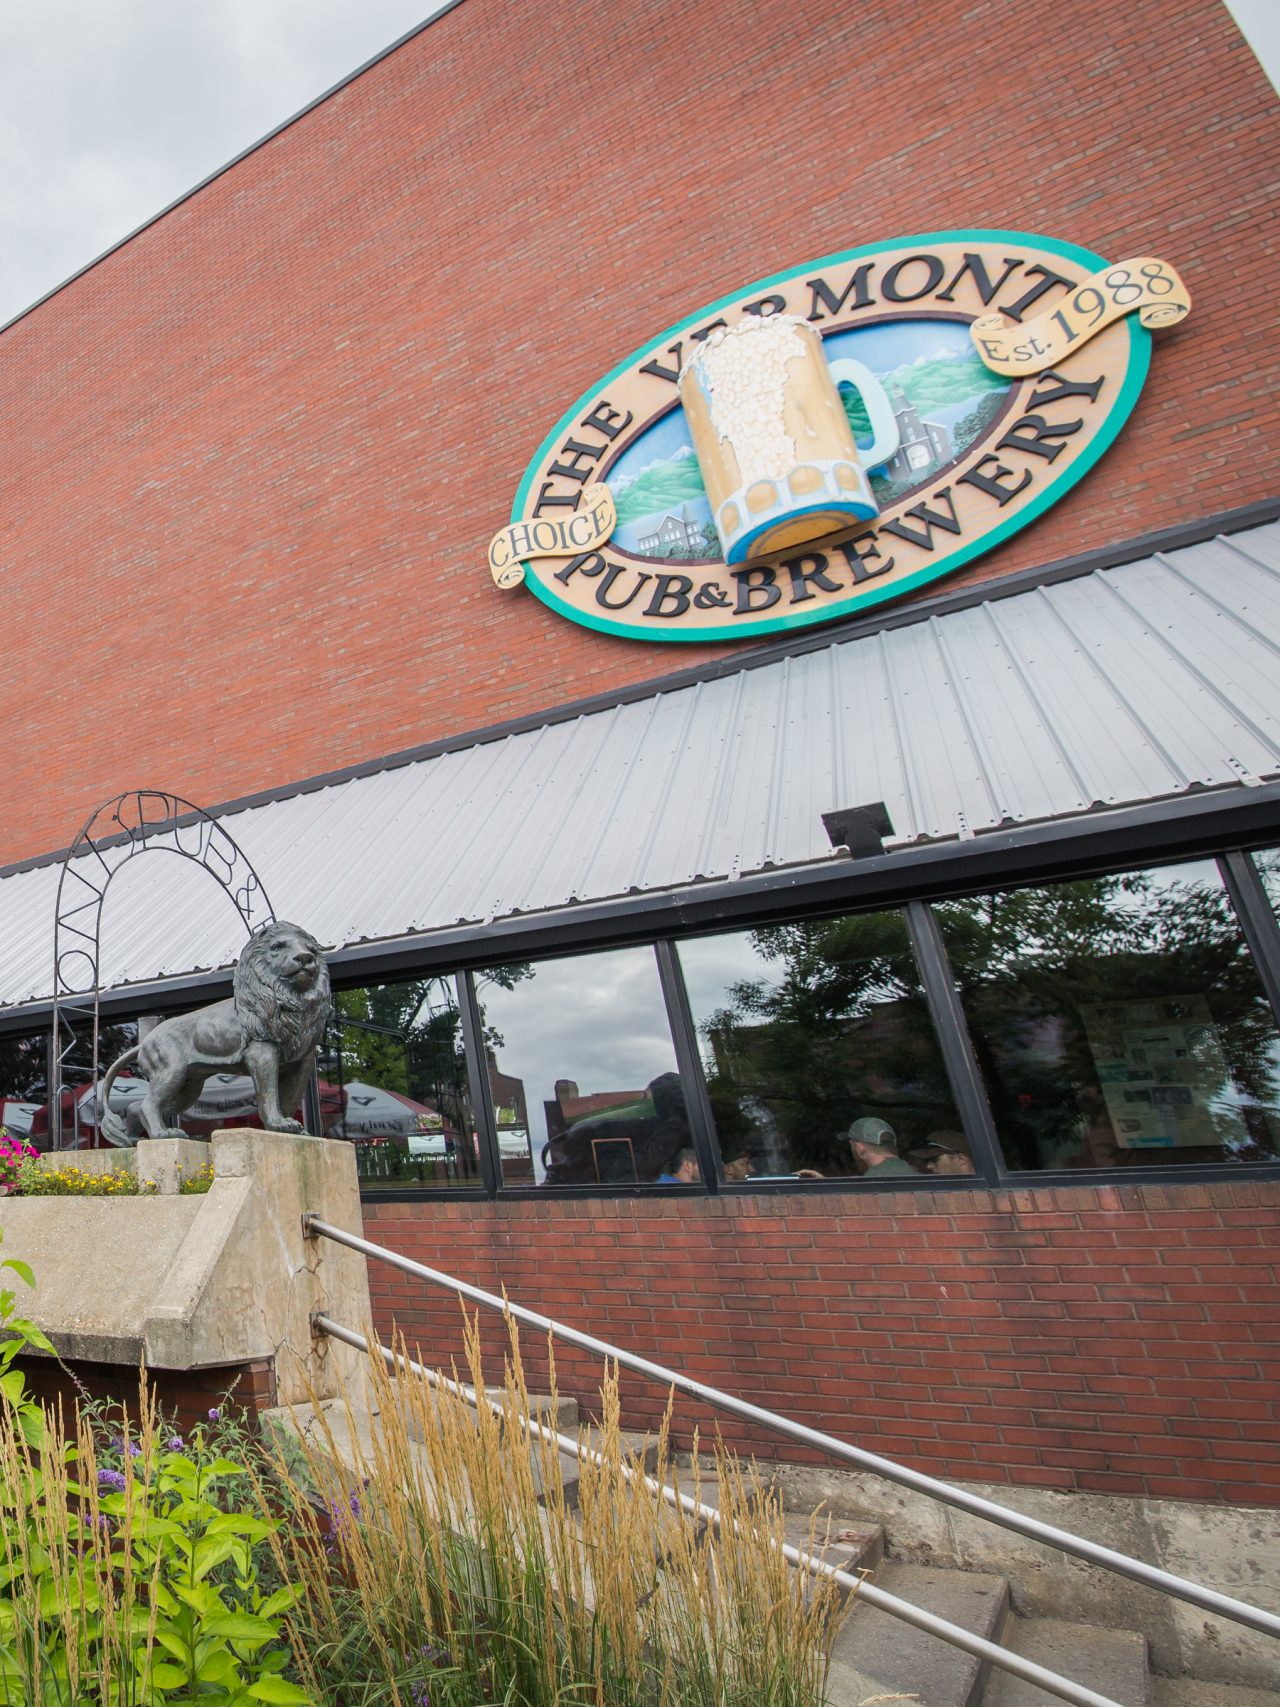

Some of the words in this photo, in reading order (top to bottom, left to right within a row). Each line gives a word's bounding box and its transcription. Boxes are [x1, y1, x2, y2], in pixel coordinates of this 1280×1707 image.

[532, 401, 634, 518] THE
[639, 253, 1078, 384] VMONT
[978, 336, 1052, 362] Est.
[1050, 263, 1175, 344] 1988
[490, 499, 613, 568] CHOICE
[730, 368, 1106, 616] BREWERY
